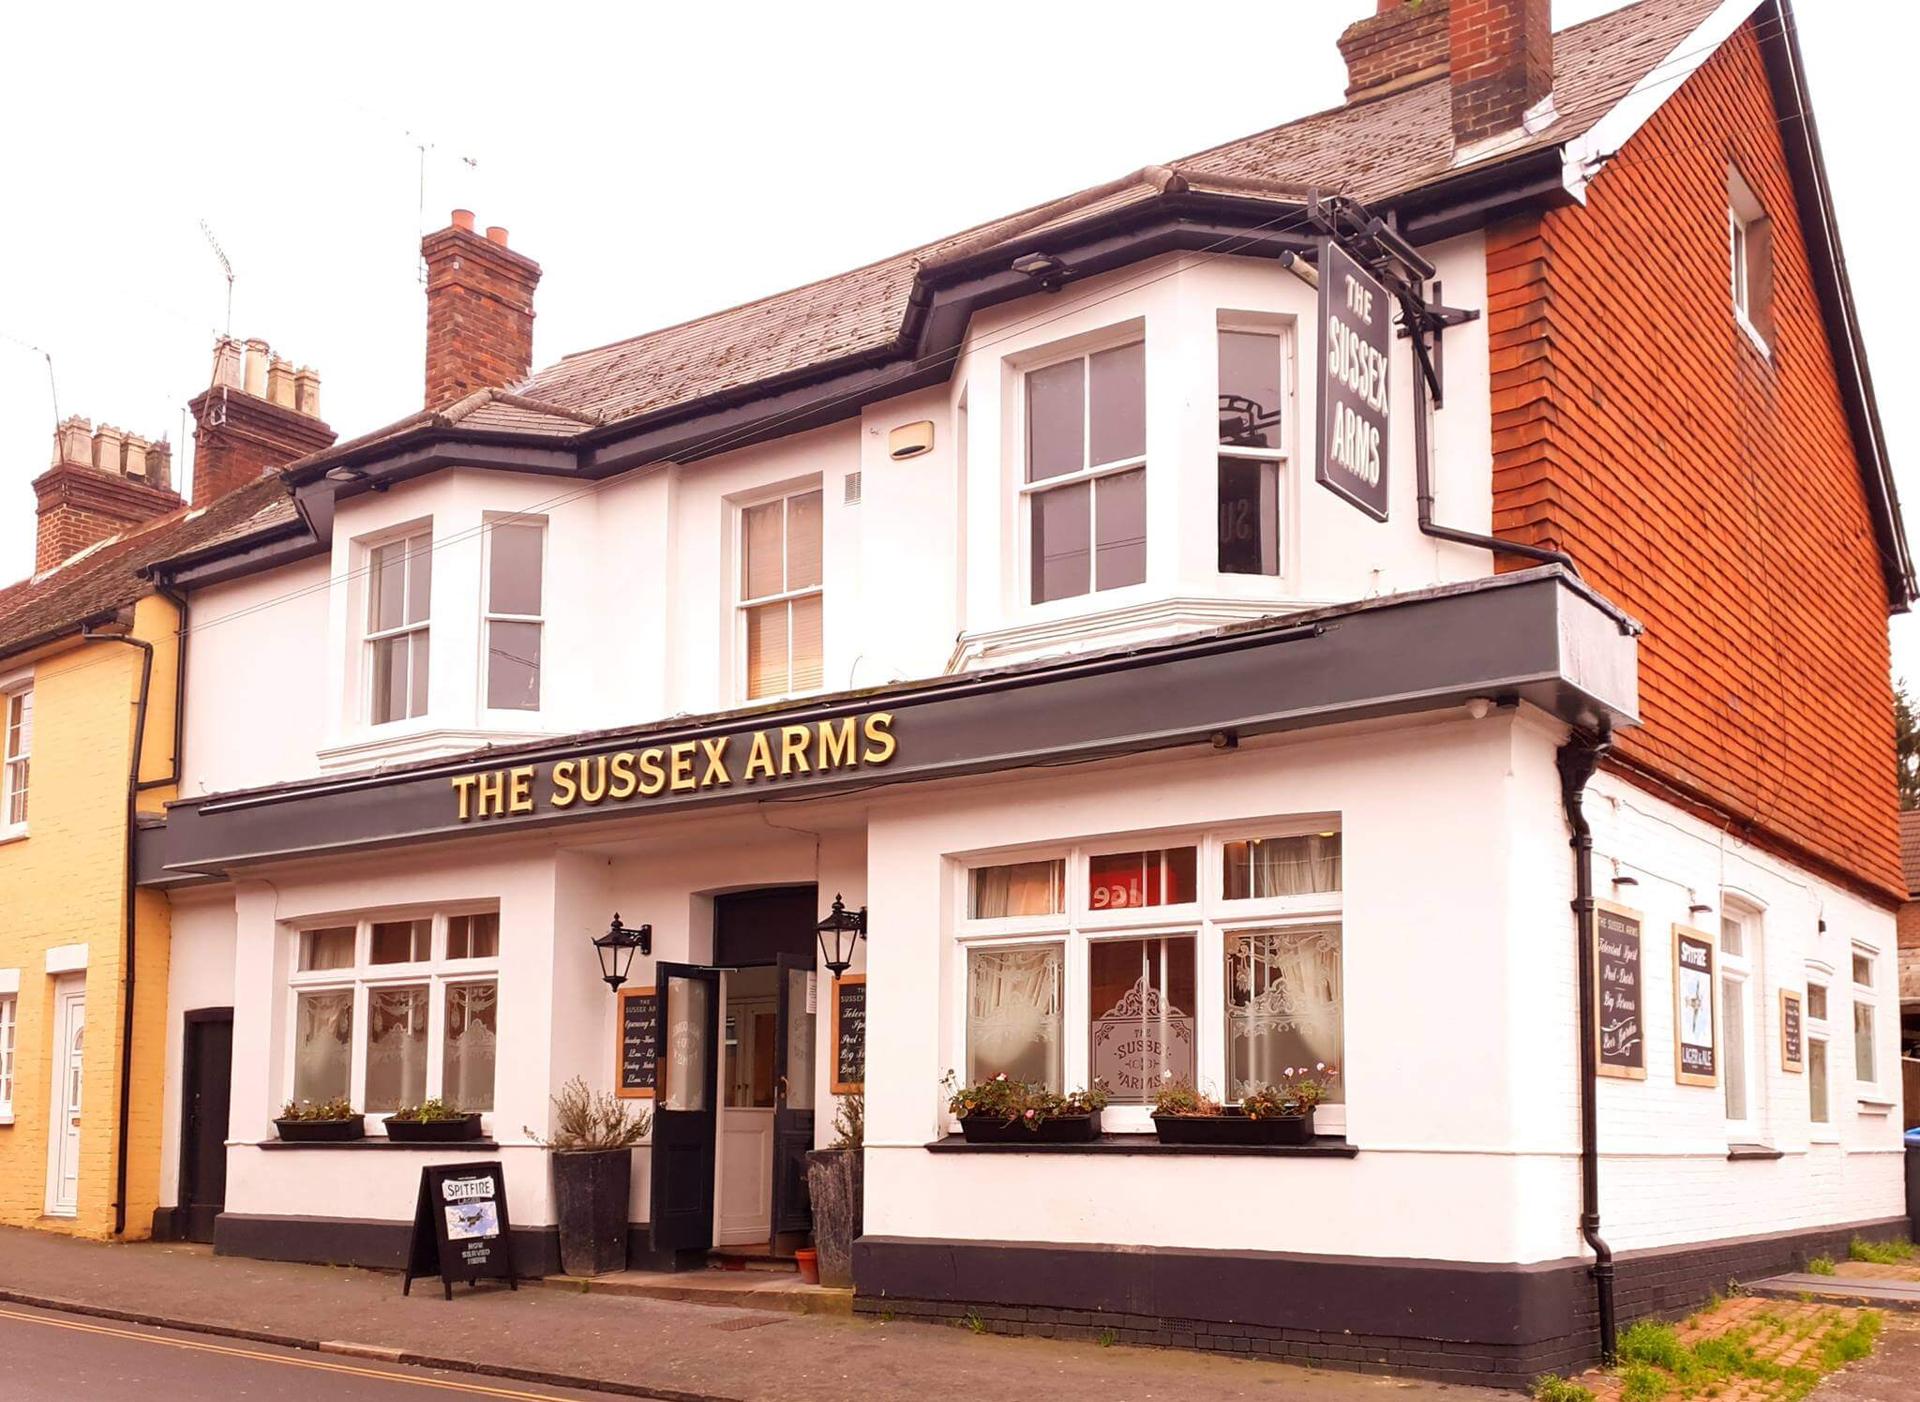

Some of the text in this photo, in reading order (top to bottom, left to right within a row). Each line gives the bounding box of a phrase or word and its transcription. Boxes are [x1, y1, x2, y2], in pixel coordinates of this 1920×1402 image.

[1345, 274, 1372, 325] THE
[1329, 316, 1388, 417] SUSSEX
[1331, 400, 1380, 487] ARMS
[451, 712, 897, 822] THE SUSSEX ARMS
[1117, 1040, 1168, 1059] SUSSE
[447, 1181, 491, 1197] SPITFIRE
[462, 1249, 490, 1258] SERVED
